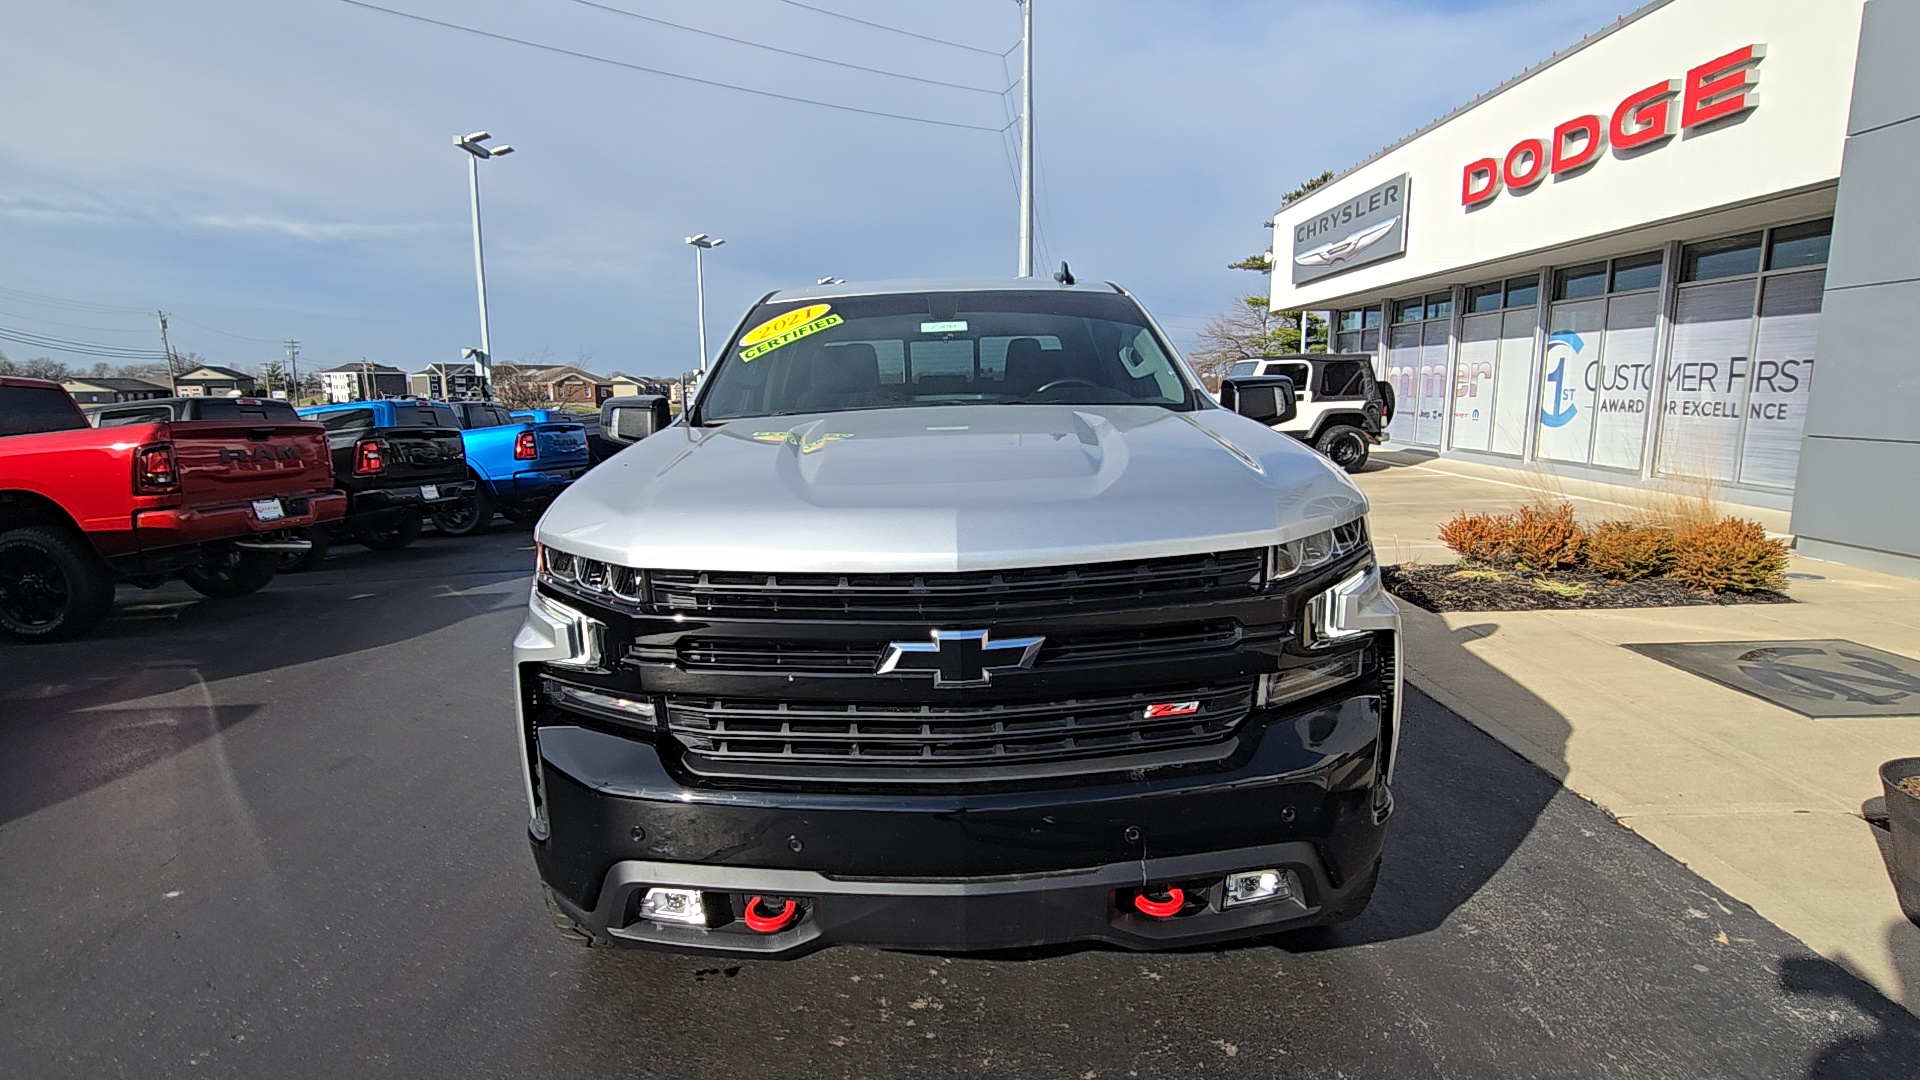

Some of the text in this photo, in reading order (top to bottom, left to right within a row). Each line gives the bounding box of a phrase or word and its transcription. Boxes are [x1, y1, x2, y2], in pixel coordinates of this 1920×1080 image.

[1462, 44, 1766, 206] DODGE
[1297, 184, 1399, 243] CHRYSLER
[744, 317, 838, 359] CERTIFIED
[759, 309, 811, 339] 2021
[1727, 356, 1815, 393] FIRST
[1600, 399, 1645, 414] AWARD
[1682, 401, 1788, 420] EXCELLNCE
[220, 445, 301, 463] RAM
[1144, 701, 1200, 718] Z71
